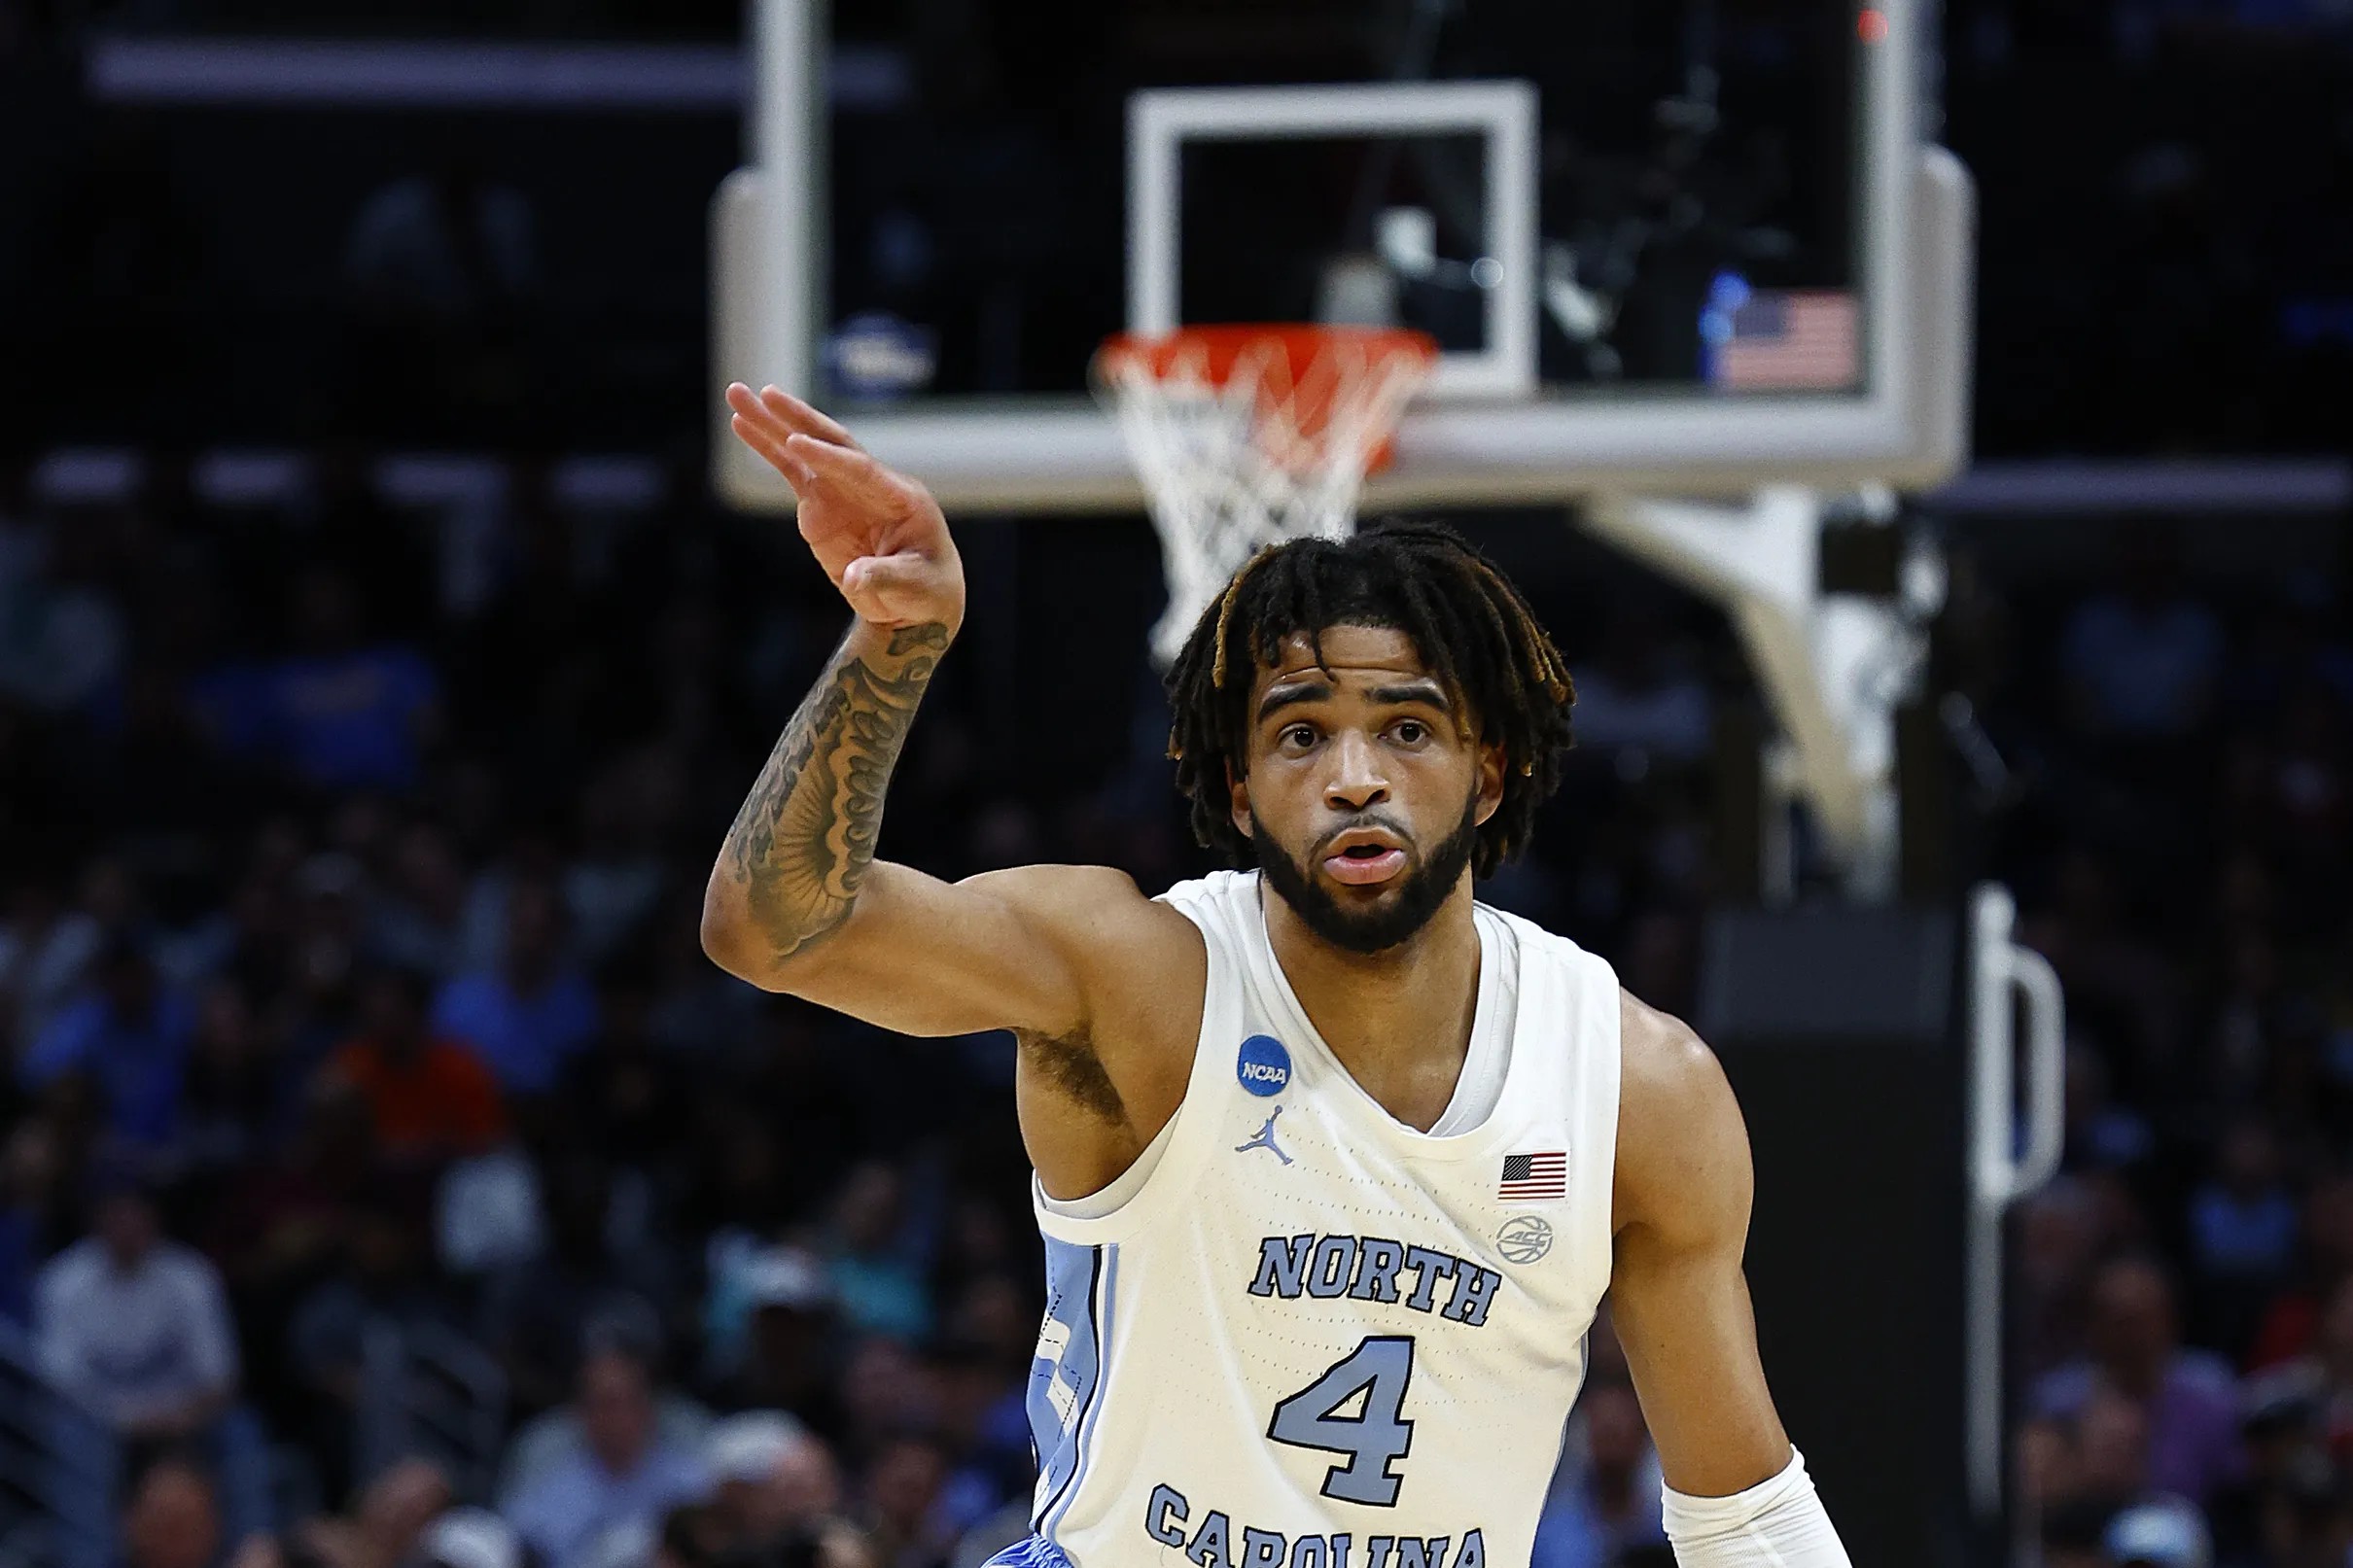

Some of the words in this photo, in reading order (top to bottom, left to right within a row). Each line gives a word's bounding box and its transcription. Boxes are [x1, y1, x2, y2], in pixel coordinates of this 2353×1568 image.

[1242, 1062, 1286, 1085] NCAA
[1503, 1230, 1553, 1248] ACC
[1248, 1233, 1502, 1327] NORTH
[1266, 1336, 1416, 1508] 4
